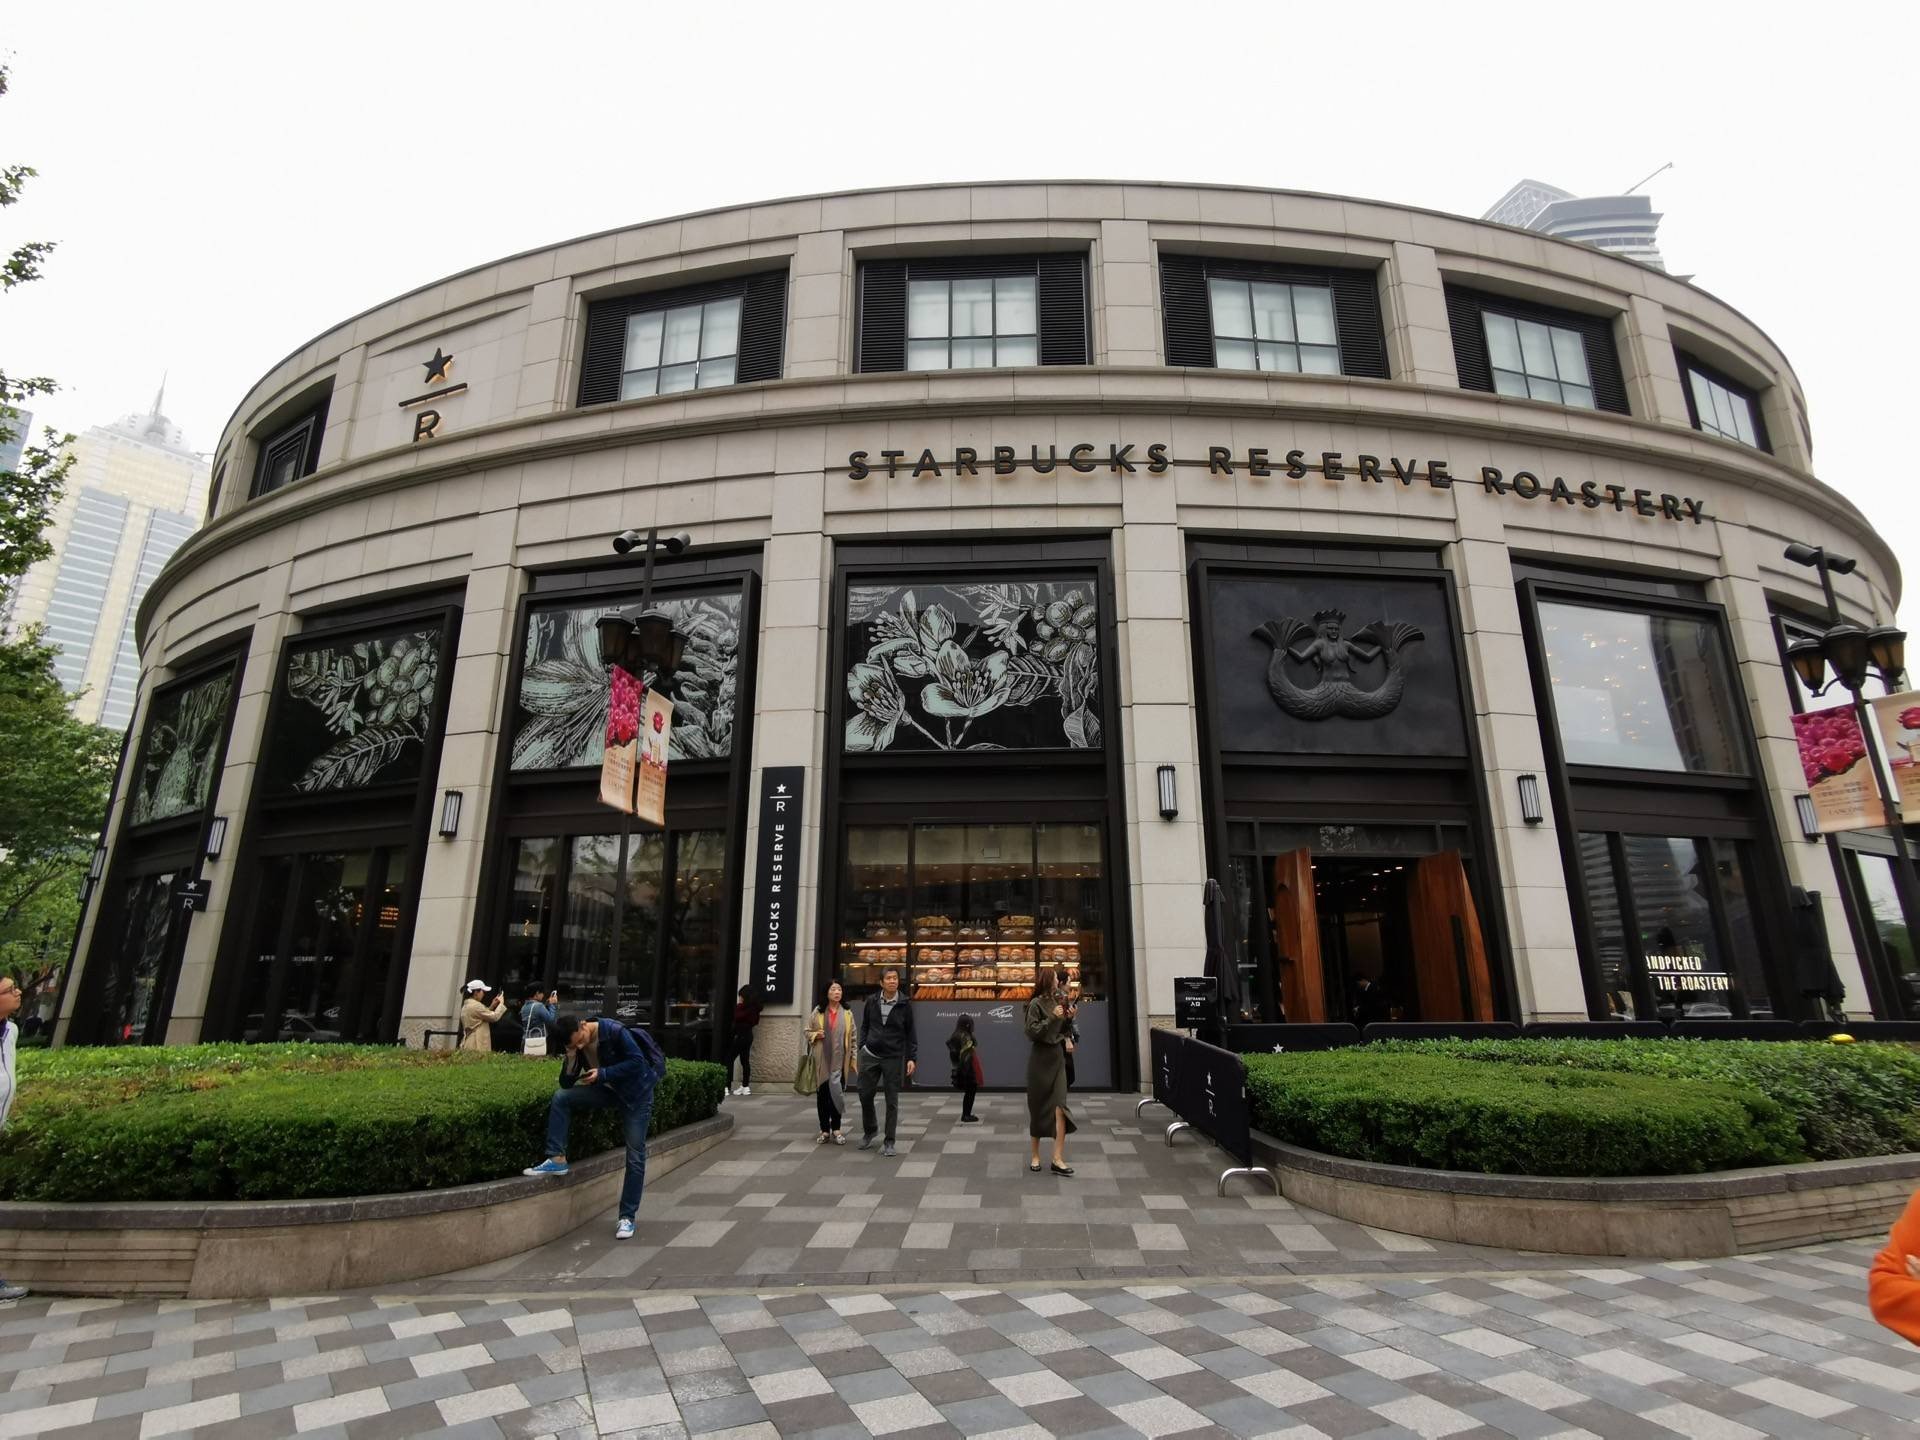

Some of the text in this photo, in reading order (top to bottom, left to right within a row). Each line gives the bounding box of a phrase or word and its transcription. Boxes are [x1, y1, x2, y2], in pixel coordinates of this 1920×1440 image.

[413, 409, 441, 442] R
[848, 443, 1704, 524] STARBUCKS RESERVE ROASTERY
[776, 801, 786, 812] R
[183, 898, 194, 909] R
[766, 823, 785, 992] STARBUCKS RESERVE
[1657, 976, 1729, 991] THE ROASTERY
